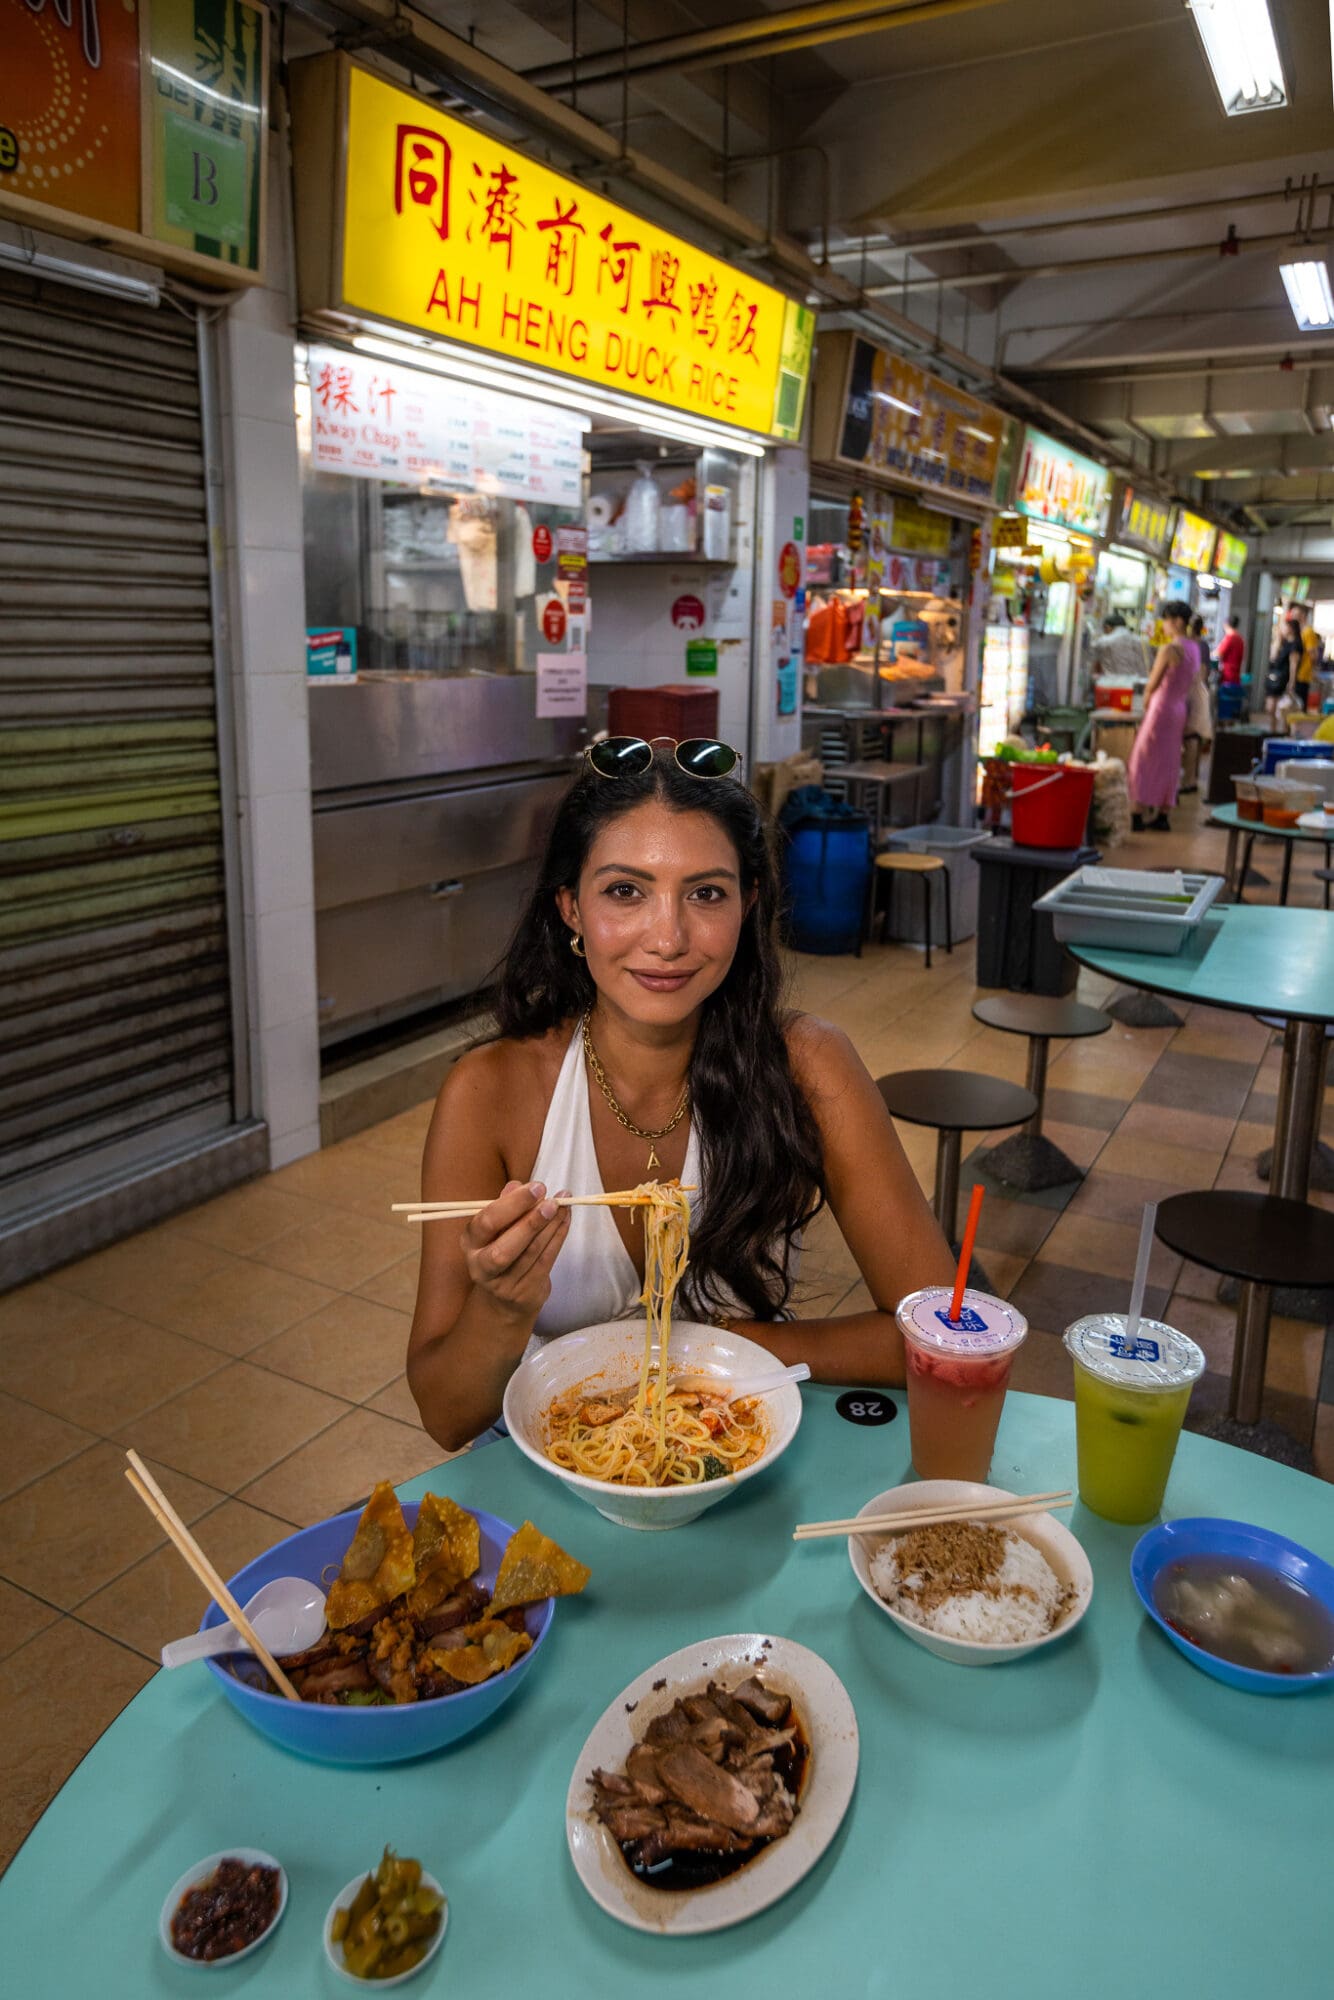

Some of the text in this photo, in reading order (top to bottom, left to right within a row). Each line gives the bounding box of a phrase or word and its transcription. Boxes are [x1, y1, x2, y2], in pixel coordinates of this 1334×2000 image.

[193, 151, 219, 206] B
[426, 267, 740, 412] AH HENG DUCK RICE
[315, 415, 357, 447] Kway
[361, 424, 401, 453] Chap
[849, 1401, 884, 1417] 28
